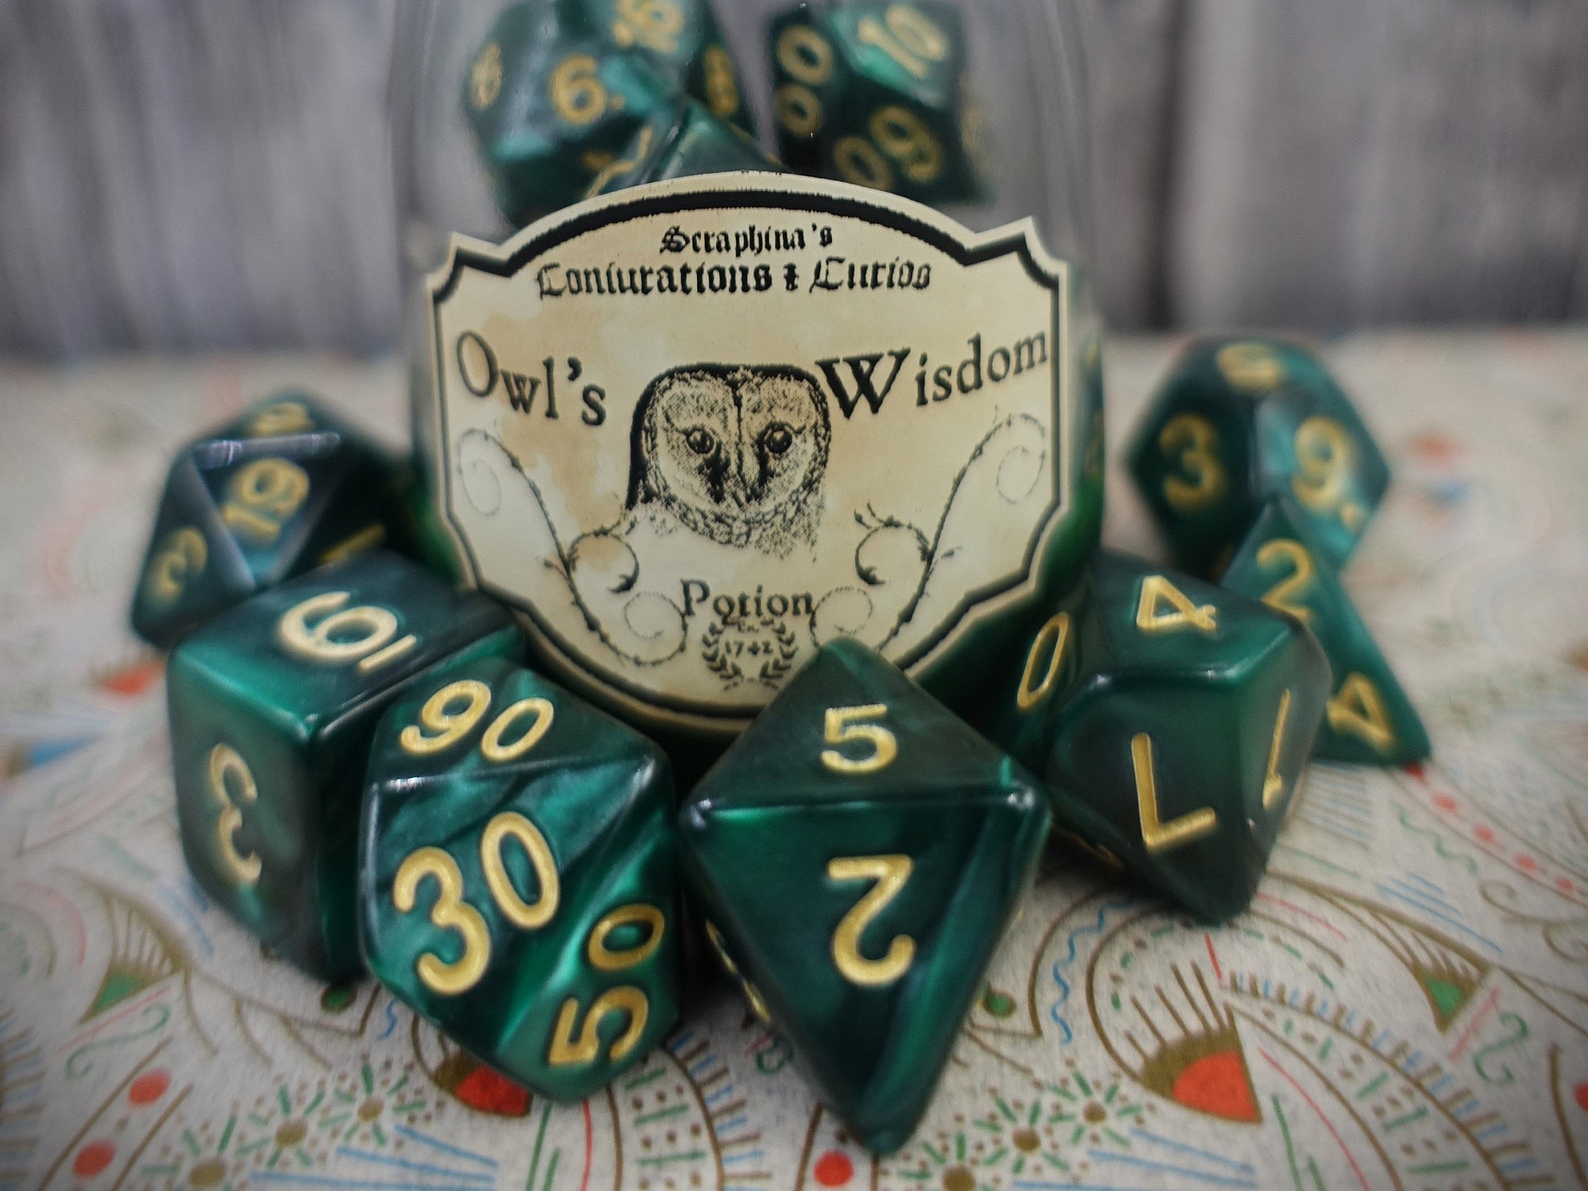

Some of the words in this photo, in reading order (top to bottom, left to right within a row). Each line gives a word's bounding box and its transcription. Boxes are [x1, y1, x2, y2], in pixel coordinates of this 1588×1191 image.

[659, 224, 833, 258] Seraphina's
[809, 256, 932, 294] Curios
[456, 329, 607, 427] Owl's
[814, 330, 1049, 421] Wisdom
[1158, 413, 1226, 513] 3
[680, 578, 814, 618] Potion
[1136, 574, 1218, 643] 4
[1256, 538, 1317, 623] 2
[1016, 612, 1071, 711] 0
[401, 678, 555, 761] 90
[820, 703, 899, 775] 5
[1326, 671, 1395, 765] 4
[392, 810, 561, 996] 30
[825, 852, 918, 989] 2
[548, 903, 667, 1068] 50
